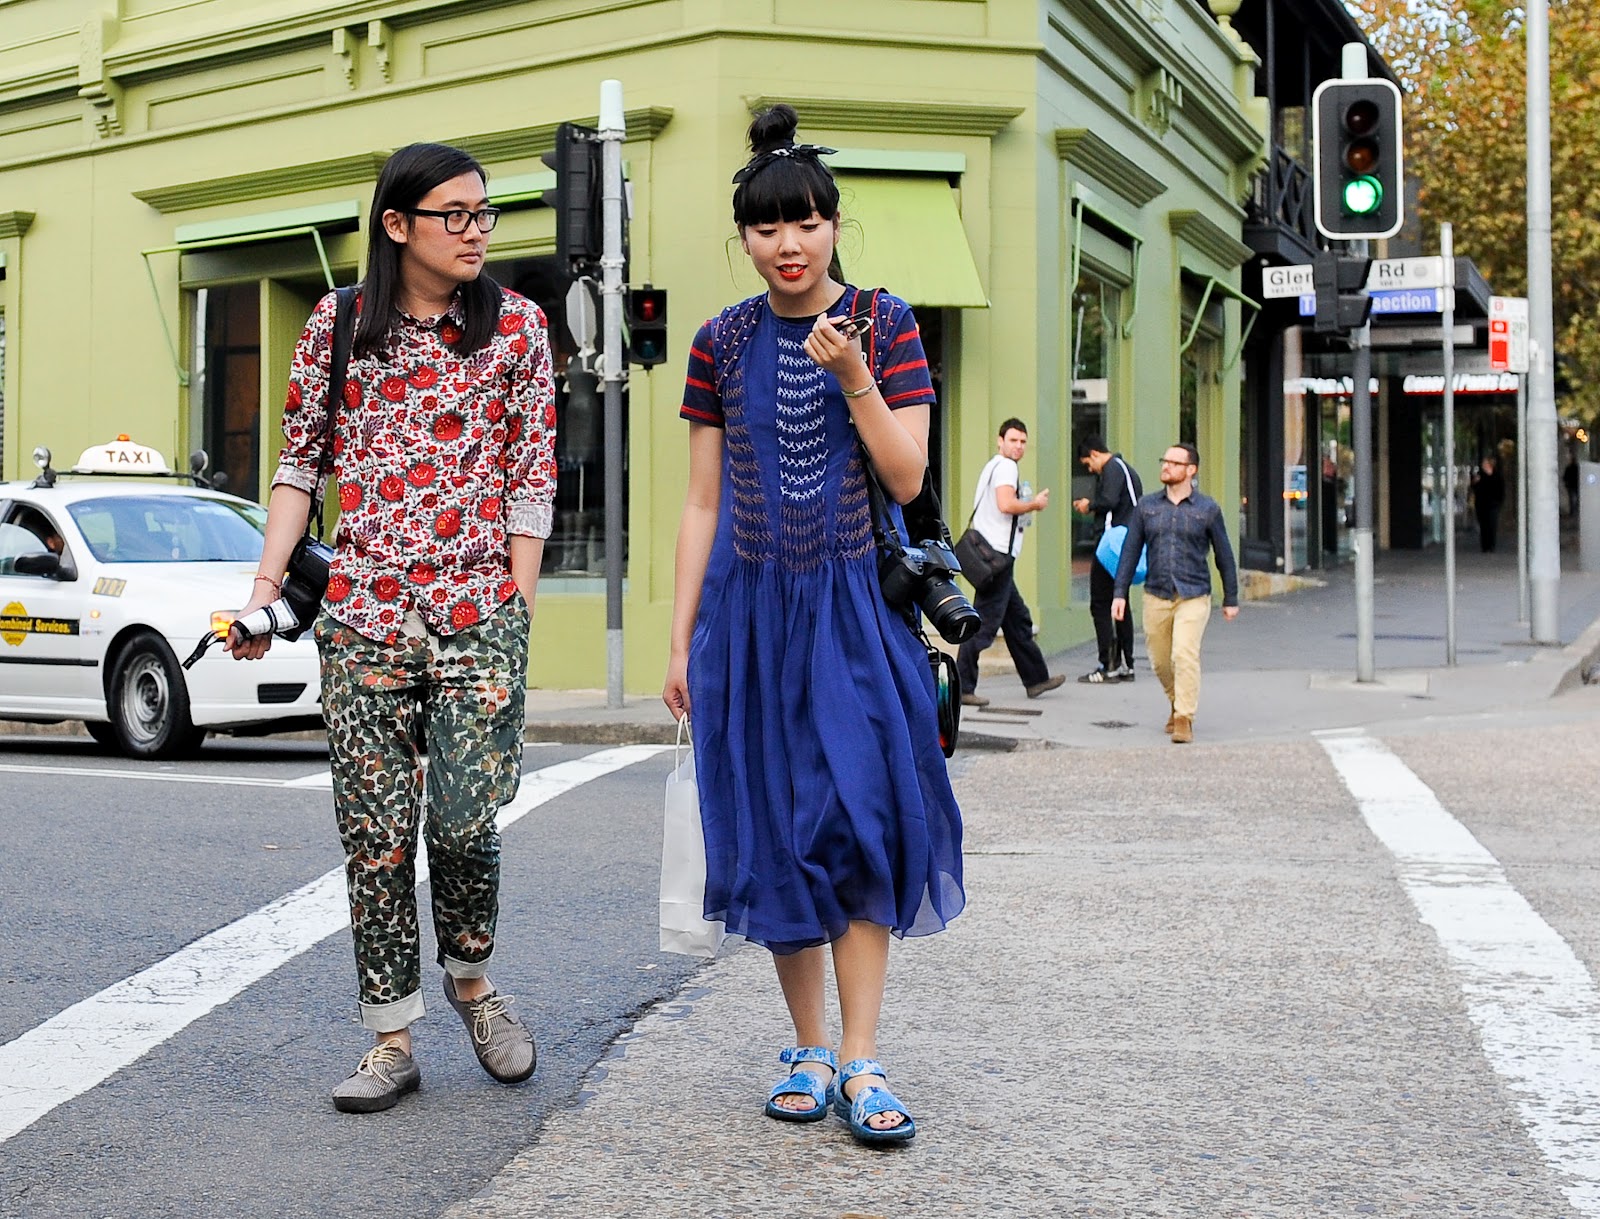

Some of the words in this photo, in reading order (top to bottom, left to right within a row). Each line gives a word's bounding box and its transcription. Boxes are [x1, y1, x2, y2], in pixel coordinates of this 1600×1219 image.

[1379, 261, 1405, 278] Rd
[105, 450, 151, 464] TAXI
[0, 617, 33, 631] ombined
